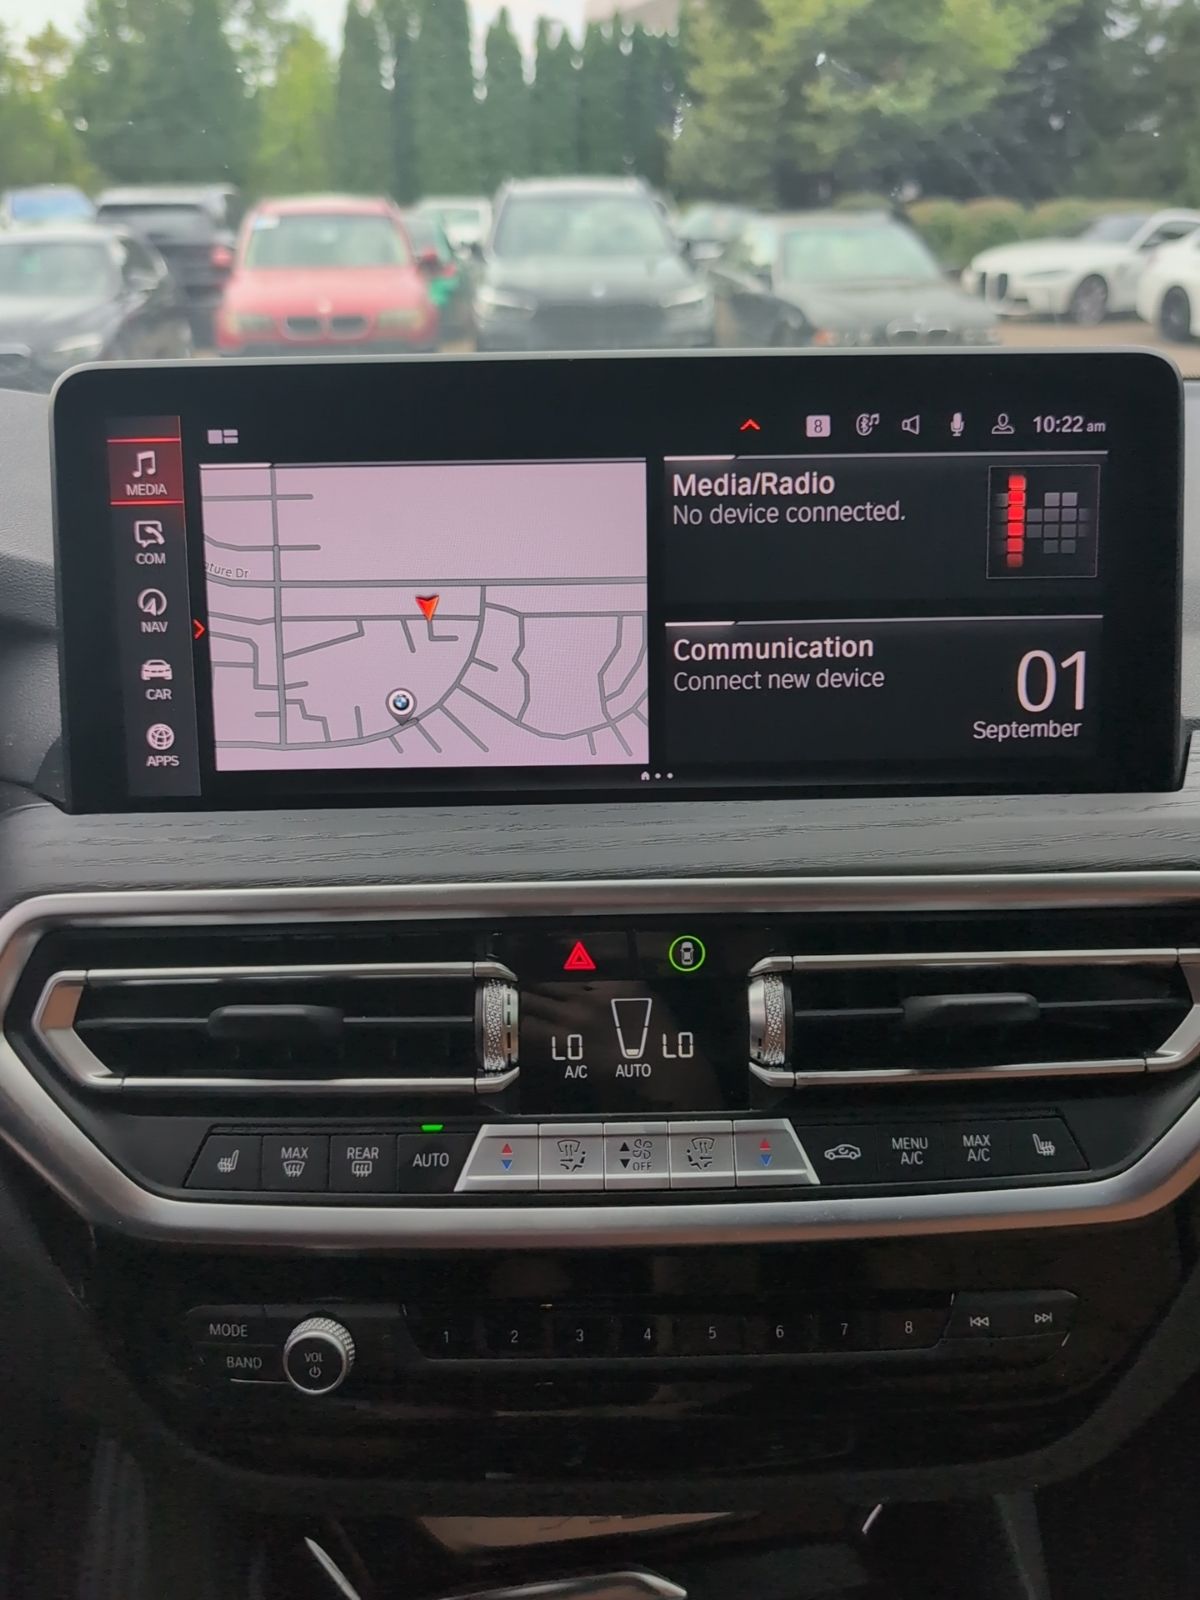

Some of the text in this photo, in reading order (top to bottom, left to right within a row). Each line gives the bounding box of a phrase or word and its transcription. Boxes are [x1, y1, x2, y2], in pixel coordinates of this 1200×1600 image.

[813, 418, 823, 433] 8
[1033, 415, 1106, 434] 10:22 am
[125, 483, 168, 496] MEDIA
[672, 471, 835, 497] Media/Radio
[672, 501, 906, 525] No device connected.
[135, 552, 166, 565] COM
[235, 568, 249, 578] Dr
[140, 620, 168, 633] NAV
[673, 636, 874, 661] Communication
[673, 667, 885, 691] Connect new device
[1017, 649, 1087, 712] 01
[145, 687, 172, 700] CAR
[972, 719, 1082, 742] September
[146, 755, 180, 767] APPS
[564, 1065, 588, 1078] A/C
[615, 1063, 652, 1078] AUTO
[892, 1136, 929, 1151] MENU
[962, 1134, 991, 1148] MAX
[281, 1147, 309, 1160] MAX
[346, 1147, 379, 1160] REAR
[412, 1153, 449, 1168] AUTO
[900, 1150, 924, 1165] A/C
[967, 1148, 991, 1162] A/C
[632, 1160, 653, 1172] OFF
[209, 1323, 248, 1338] MODE
[643, 1327, 652, 1341] 4
[708, 1326, 717, 1340] 5
[775, 1324, 784, 1338] 6
[840, 1323, 849, 1336] 7
[904, 1320, 914, 1334] 8
[443, 1330, 450, 1343] 1
[510, 1330, 519, 1344] 2
[575, 1329, 584, 1343] 3
[226, 1355, 262, 1369] BAND
[304, 1352, 324, 1363] VOL
